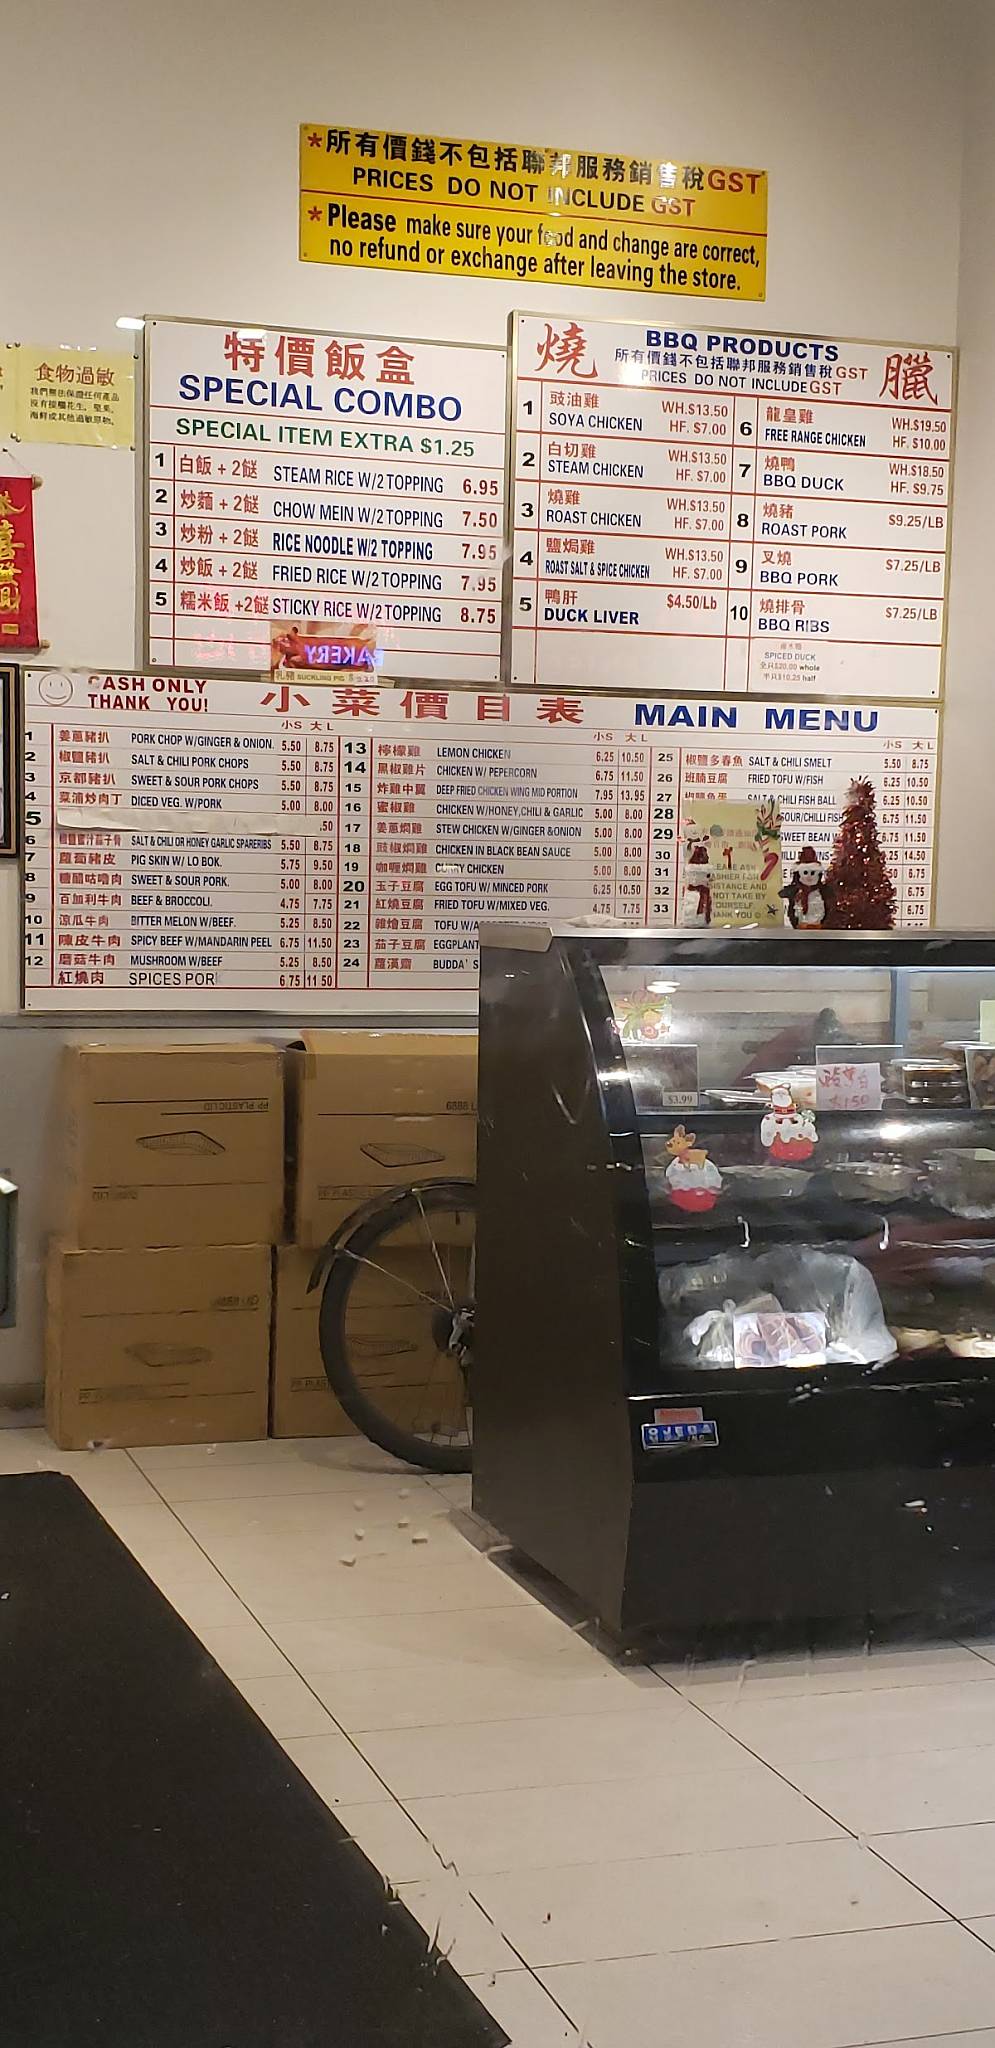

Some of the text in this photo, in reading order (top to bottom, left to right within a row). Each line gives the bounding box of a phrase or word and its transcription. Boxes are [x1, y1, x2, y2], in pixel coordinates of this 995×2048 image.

[353, 167, 696, 217] PRICES DO NOT INCLUDE GST
[327, 203, 397, 233] Please
[406, 215, 452, 238] make
[456, 221, 492, 240] sure
[496, 225, 533, 247] your
[579, 228, 609, 250] and
[613, 232, 670, 260] change
[674, 240, 698, 259] are
[703, 241, 760, 268] correct,
[330, 237, 741, 292] no refund or exchange after leaving the store.
[646, 329, 839, 363] BBQ PRODUCTS
[224, 331, 415, 385] 特價飯盒
[34, 362, 115, 387] 食物過敏
[179, 374, 462, 422] SPECIAL COMBO
[550, 390, 600, 409] 豉油雞
[523, 400, 533, 415] 1
[766, 405, 814, 424] 龍皇雞
[549, 412, 643, 432] SOYA CHICKEN
[669, 420, 690, 434] HF.
[740, 421, 752, 436] 6
[176, 417, 475, 458] SPECIAL ITEM EXTRA $1.25
[765, 428, 866, 448] FREE RANGE CHICKEN
[892, 435, 909, 449] HF.
[155, 453, 165, 467] 1
[179, 454, 211, 476] 白飯
[273, 465, 320, 485] STEAM
[325, 469, 354, 488] RICE
[386, 473, 444, 494] TOPPING
[462, 478, 499, 497] 6.95
[547, 488, 581, 505] 燒雞
[521, 503, 534, 517] 3
[546, 509, 642, 528] ROAST CHICKEN
[762, 502, 793, 520] 燒豬
[674, 516, 692, 530] HF.
[737, 513, 749, 528] 8
[761, 522, 847, 539] ROAST PORK
[155, 522, 167, 537] 3
[180, 522, 214, 545] 炒粉
[273, 532, 301, 552] RICE
[305, 533, 354, 557] NOODLE
[381, 538, 433, 561] TOPPING
[461, 543, 498, 561] 7.95
[155, 592, 168, 607] 5
[180, 589, 229, 613] 糯米飯
[272, 597, 319, 618] STICKY
[324, 600, 352, 619] RICE
[384, 606, 441, 623] TOPPING
[460, 607, 496, 624] 8.75
[519, 597, 532, 612] 5
[545, 589, 578, 606] 鴨肝
[666, 593, 717, 610] $4.50/Lb
[544, 607, 639, 625] DUCK LIVER
[730, 605, 748, 621] 10
[759, 599, 805, 615] 燒排骨
[758, 618, 830, 633] BBQ RIBS
[152, 678, 207, 694] ONLY
[88, 694, 208, 712] THANK YOU!
[260, 686, 584, 724] 小菜價目表
[634, 703, 879, 732] MAIN MENU
[657, 753, 673, 762] 25
[749, 756, 771, 767] SALT
[772, 757, 778, 767] &
[781, 757, 802, 768] CHILI
[803, 757, 832, 768] SMELT
[884, 758, 901, 769] 5.50
[912, 759, 929, 769] 8.75
[26, 792, 37, 801] 4
[131, 795, 158, 807] DICED
[161, 797, 183, 808] VEG.
[185, 797, 222, 809] W/PORK
[281, 800, 301, 812] 5.00
[314, 801, 334, 813] 8.00
[343, 881, 365, 892] 20
[434, 882, 453, 892] EGG
[455, 882, 476, 893] TOFU
[478, 882, 490, 894] W/
[492, 882, 525, 894] MINCED
[526, 883, 548, 893] PORK
[593, 884, 611, 895] 6.25
[619, 884, 641, 895] 10.50
[131, 935, 158, 946] SPICY
[160, 935, 182, 947] BEEF
[185, 936, 249, 948] W/MANDARIN
[250, 936, 272, 948] PEEL
[280, 937, 300, 948] 6.75
[307, 937, 332, 949] 11.50
